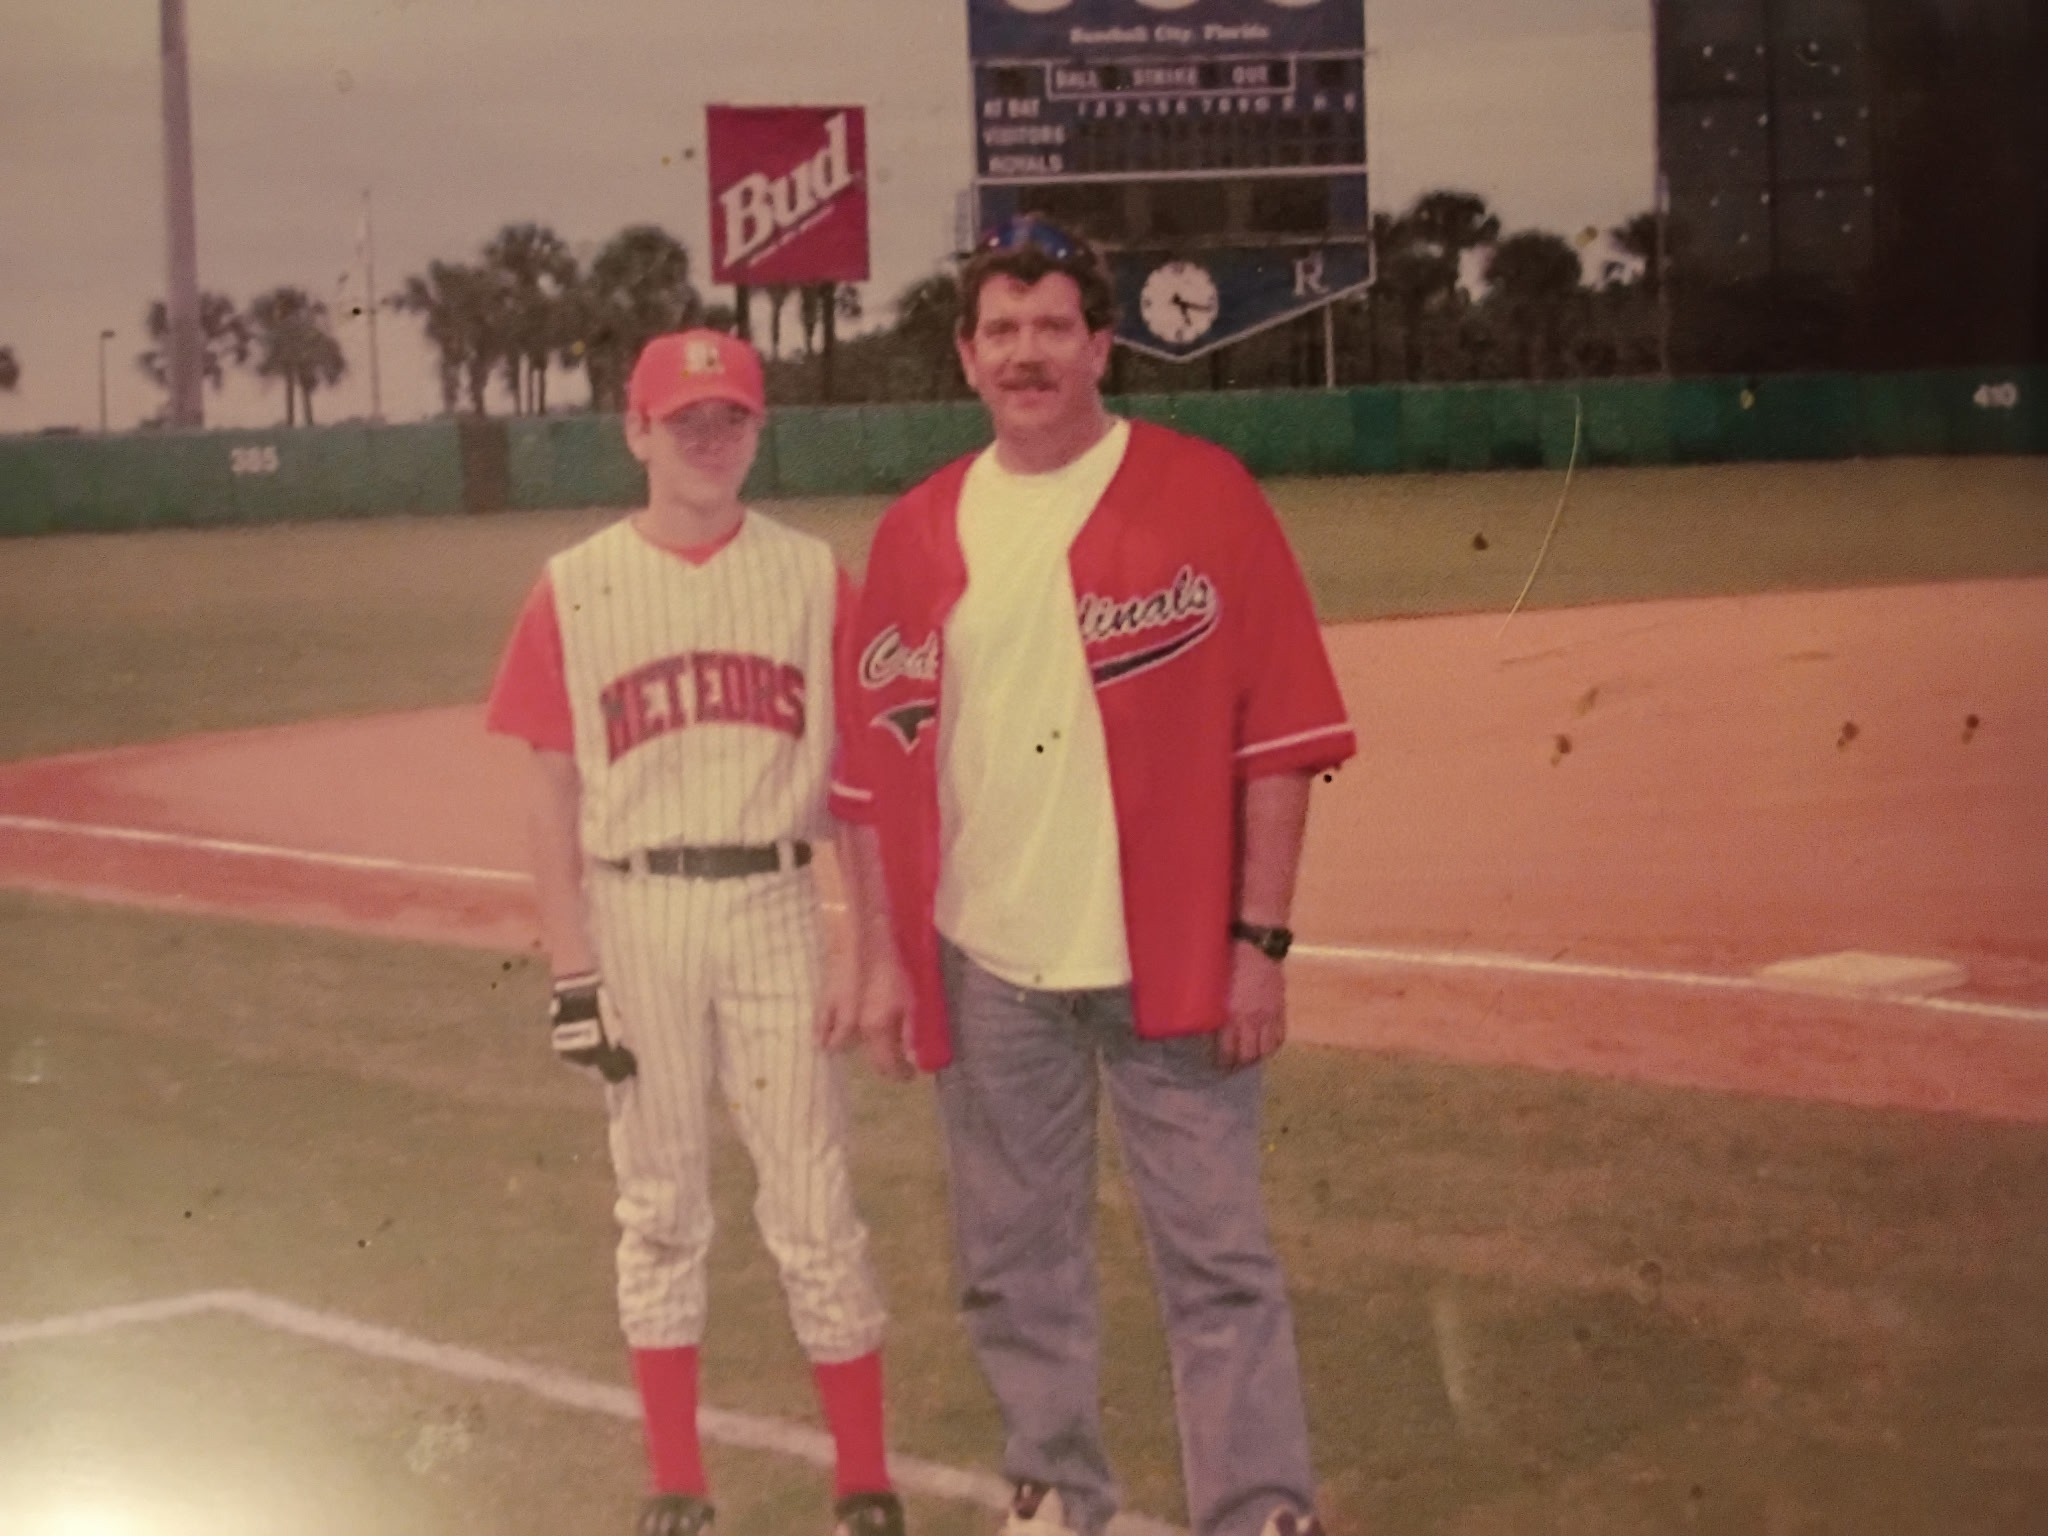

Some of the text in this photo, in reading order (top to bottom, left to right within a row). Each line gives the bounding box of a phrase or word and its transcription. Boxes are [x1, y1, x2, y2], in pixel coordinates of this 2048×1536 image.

[1007, 98, 1040, 117] BAT
[718, 112, 854, 269] Bud
[599, 650, 805, 766] METEORS
